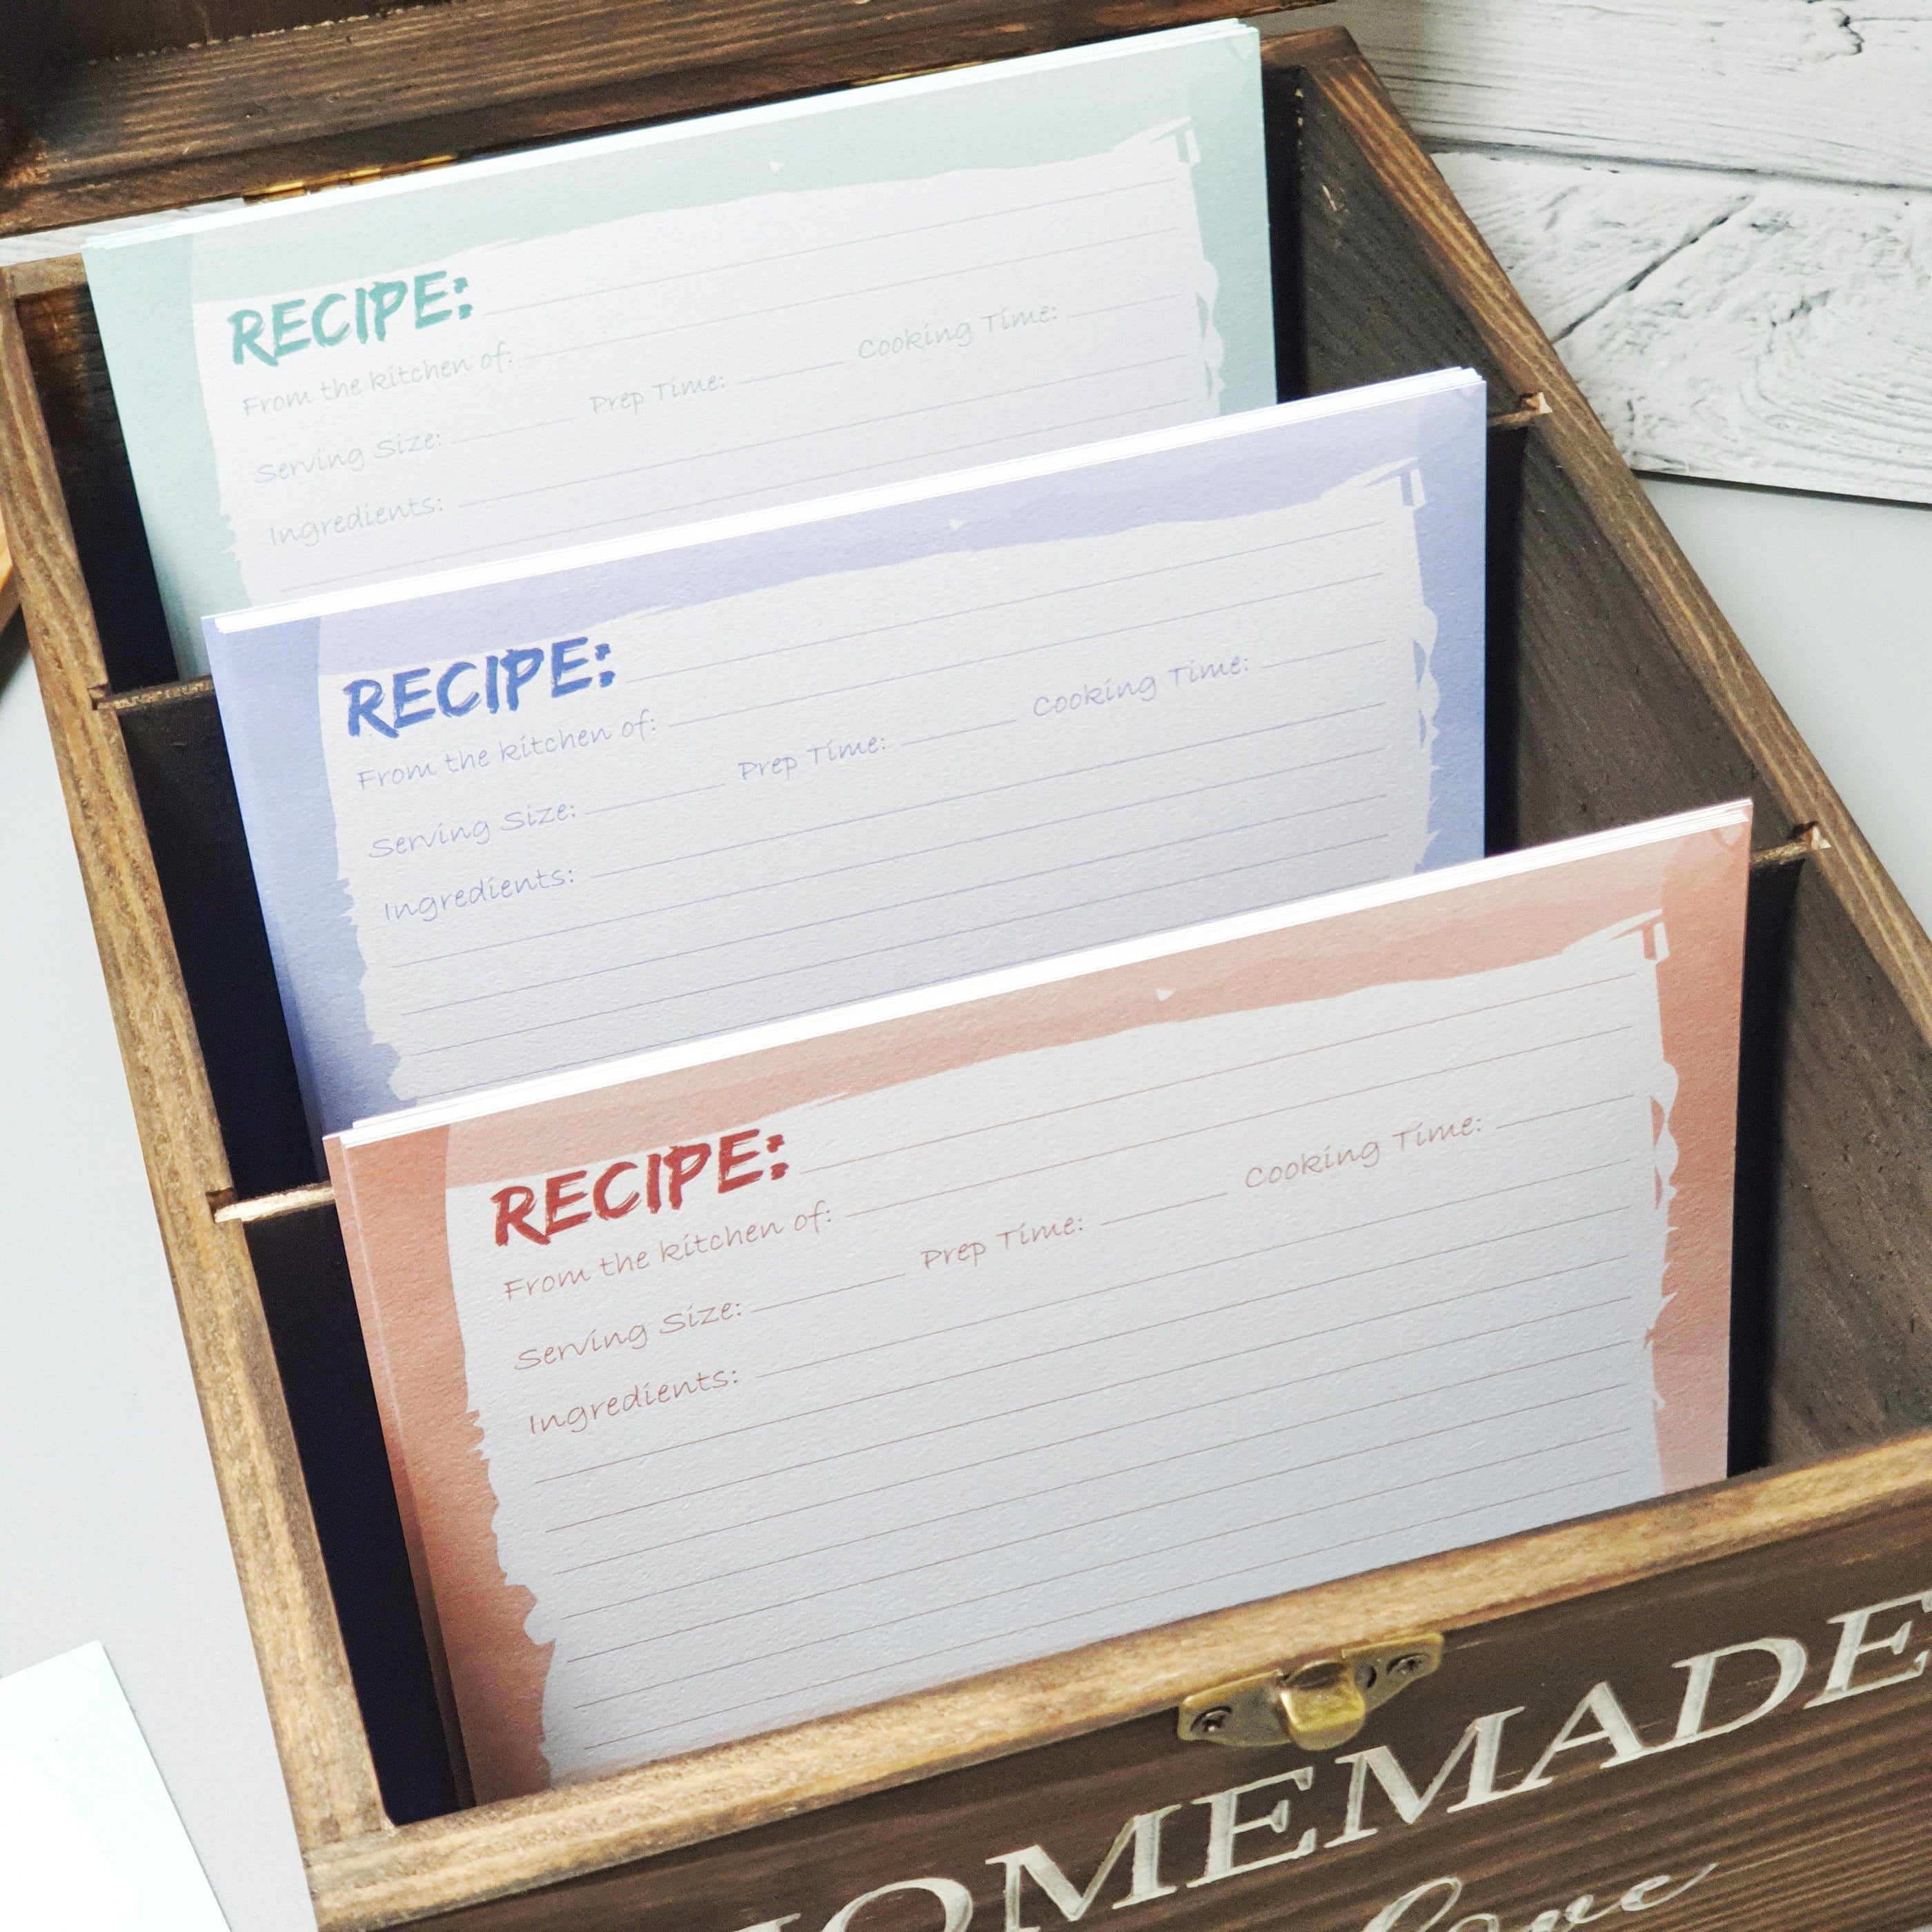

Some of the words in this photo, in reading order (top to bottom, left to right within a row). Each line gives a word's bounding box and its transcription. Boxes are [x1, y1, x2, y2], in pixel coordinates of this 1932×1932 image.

[228, 270, 474, 368] RECIPE:
[242, 391, 314, 416] From
[320, 373, 363, 400] the
[370, 357, 474, 391] kitchen
[480, 340, 513, 374] of:
[254, 448, 366, 484] Serving
[373, 431, 443, 460] Size:
[589, 390, 644, 415] Prep
[651, 375, 726, 400] Time:
[858, 323, 974, 360] Cooking
[980, 305, 1058, 333] Time:
[269, 494, 444, 547] Ingredients:
[342, 636, 616, 738] RECIPE:
[357, 760, 438, 791] From
[445, 745, 491, 774] the
[500, 728, 613, 762] kitchen
[621, 709, 657, 744] of:
[368, 820, 491, 858] Serving
[503, 802, 577, 834] Size:
[738, 755, 798, 782] Prep
[807, 733, 888, 767] Time:
[1032, 675, 1158, 718] Cooking
[1167, 653, 1249, 684] Time:
[384, 867, 575, 923] Ingredients:
[490, 1128, 790, 1246] RECIPE:
[502, 1268, 592, 1302] From
[599, 1250, 651, 1278] the
[659, 1220, 785, 1263] kitchen
[792, 1200, 834, 1241] of:
[514, 1323, 649, 1371] Serving
[659, 1301, 743, 1336] Size:
[920, 1242, 987, 1271] Prep
[996, 1219, 1085, 1252] Time:
[1244, 1144, 1381, 1190] Cooking
[1392, 1115, 1483, 1152] Time:
[529, 1368, 738, 1435] Ingredients:
[733, 1589, 1932, 1932] OMEMADE
